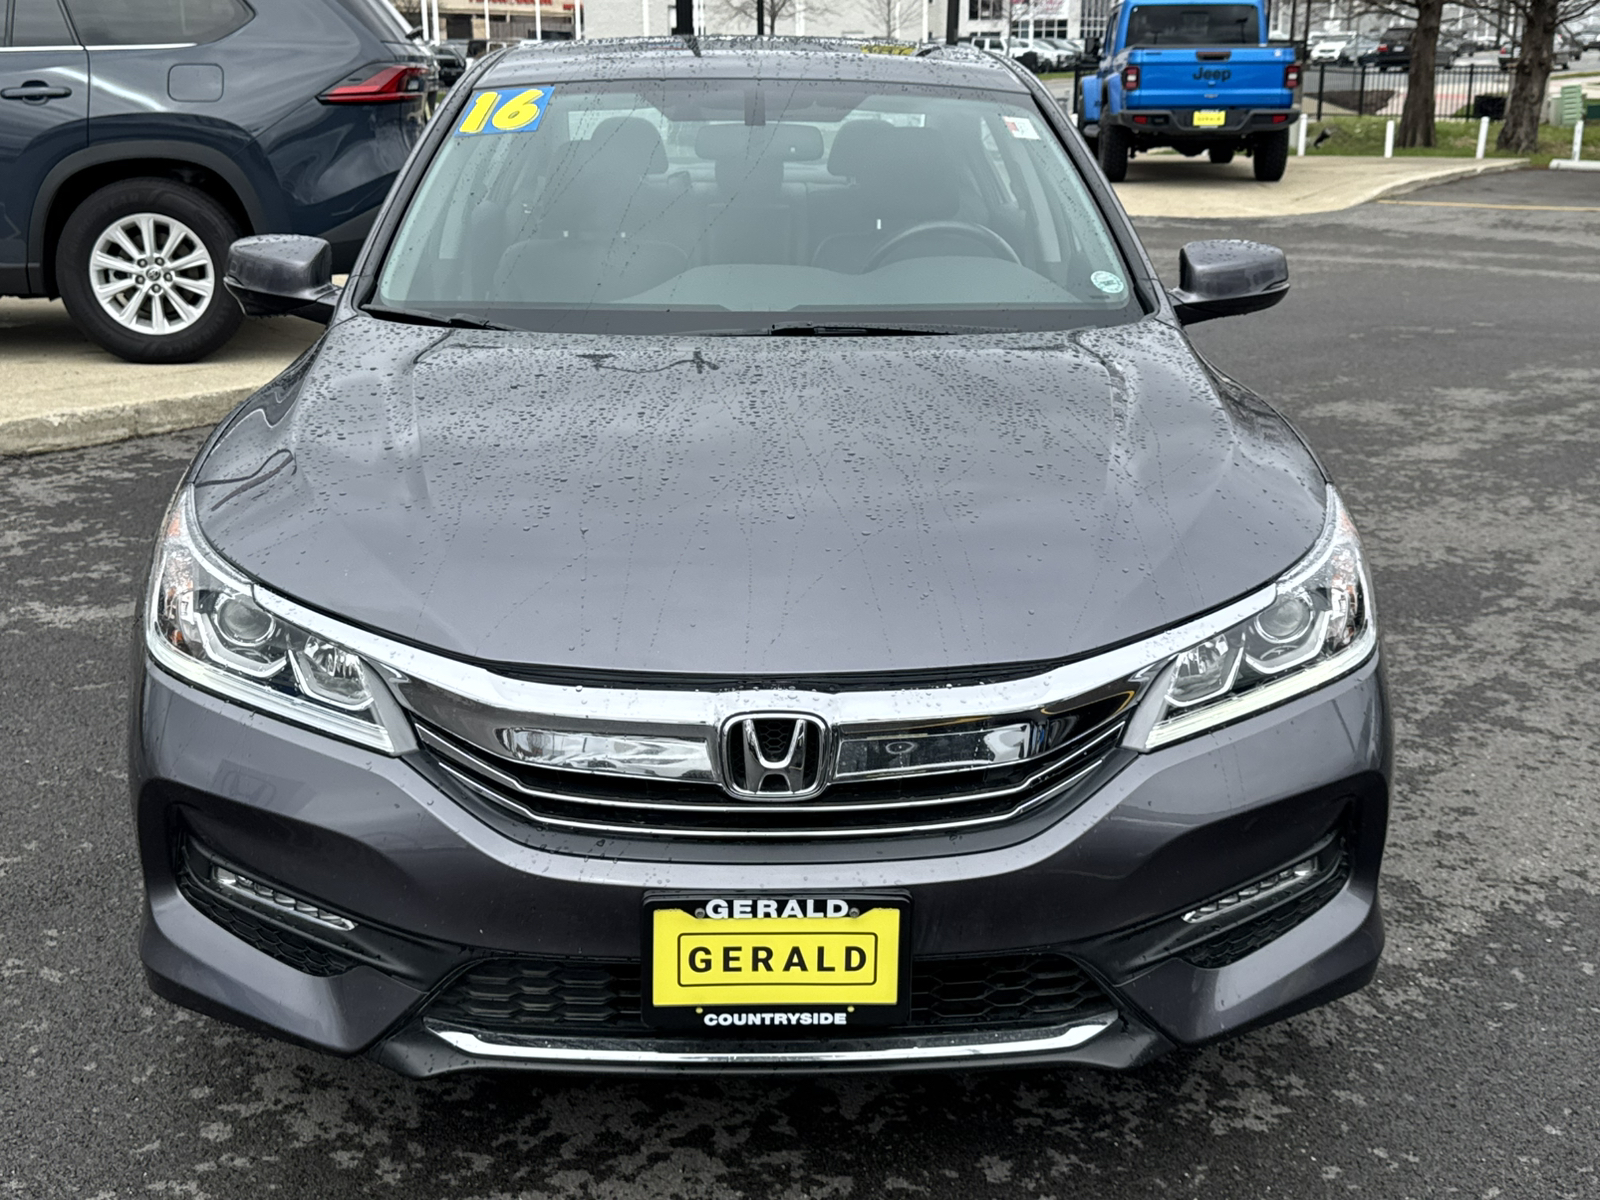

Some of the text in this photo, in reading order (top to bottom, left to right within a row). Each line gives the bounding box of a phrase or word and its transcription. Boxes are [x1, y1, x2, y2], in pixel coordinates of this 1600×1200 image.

[1193, 67, 1231, 81] Jeep
[459, 88, 543, 133] 16
[705, 899, 849, 918] GERALD
[688, 946, 867, 973] GERALD
[703, 1013, 847, 1026] COUNTRYSIDE
